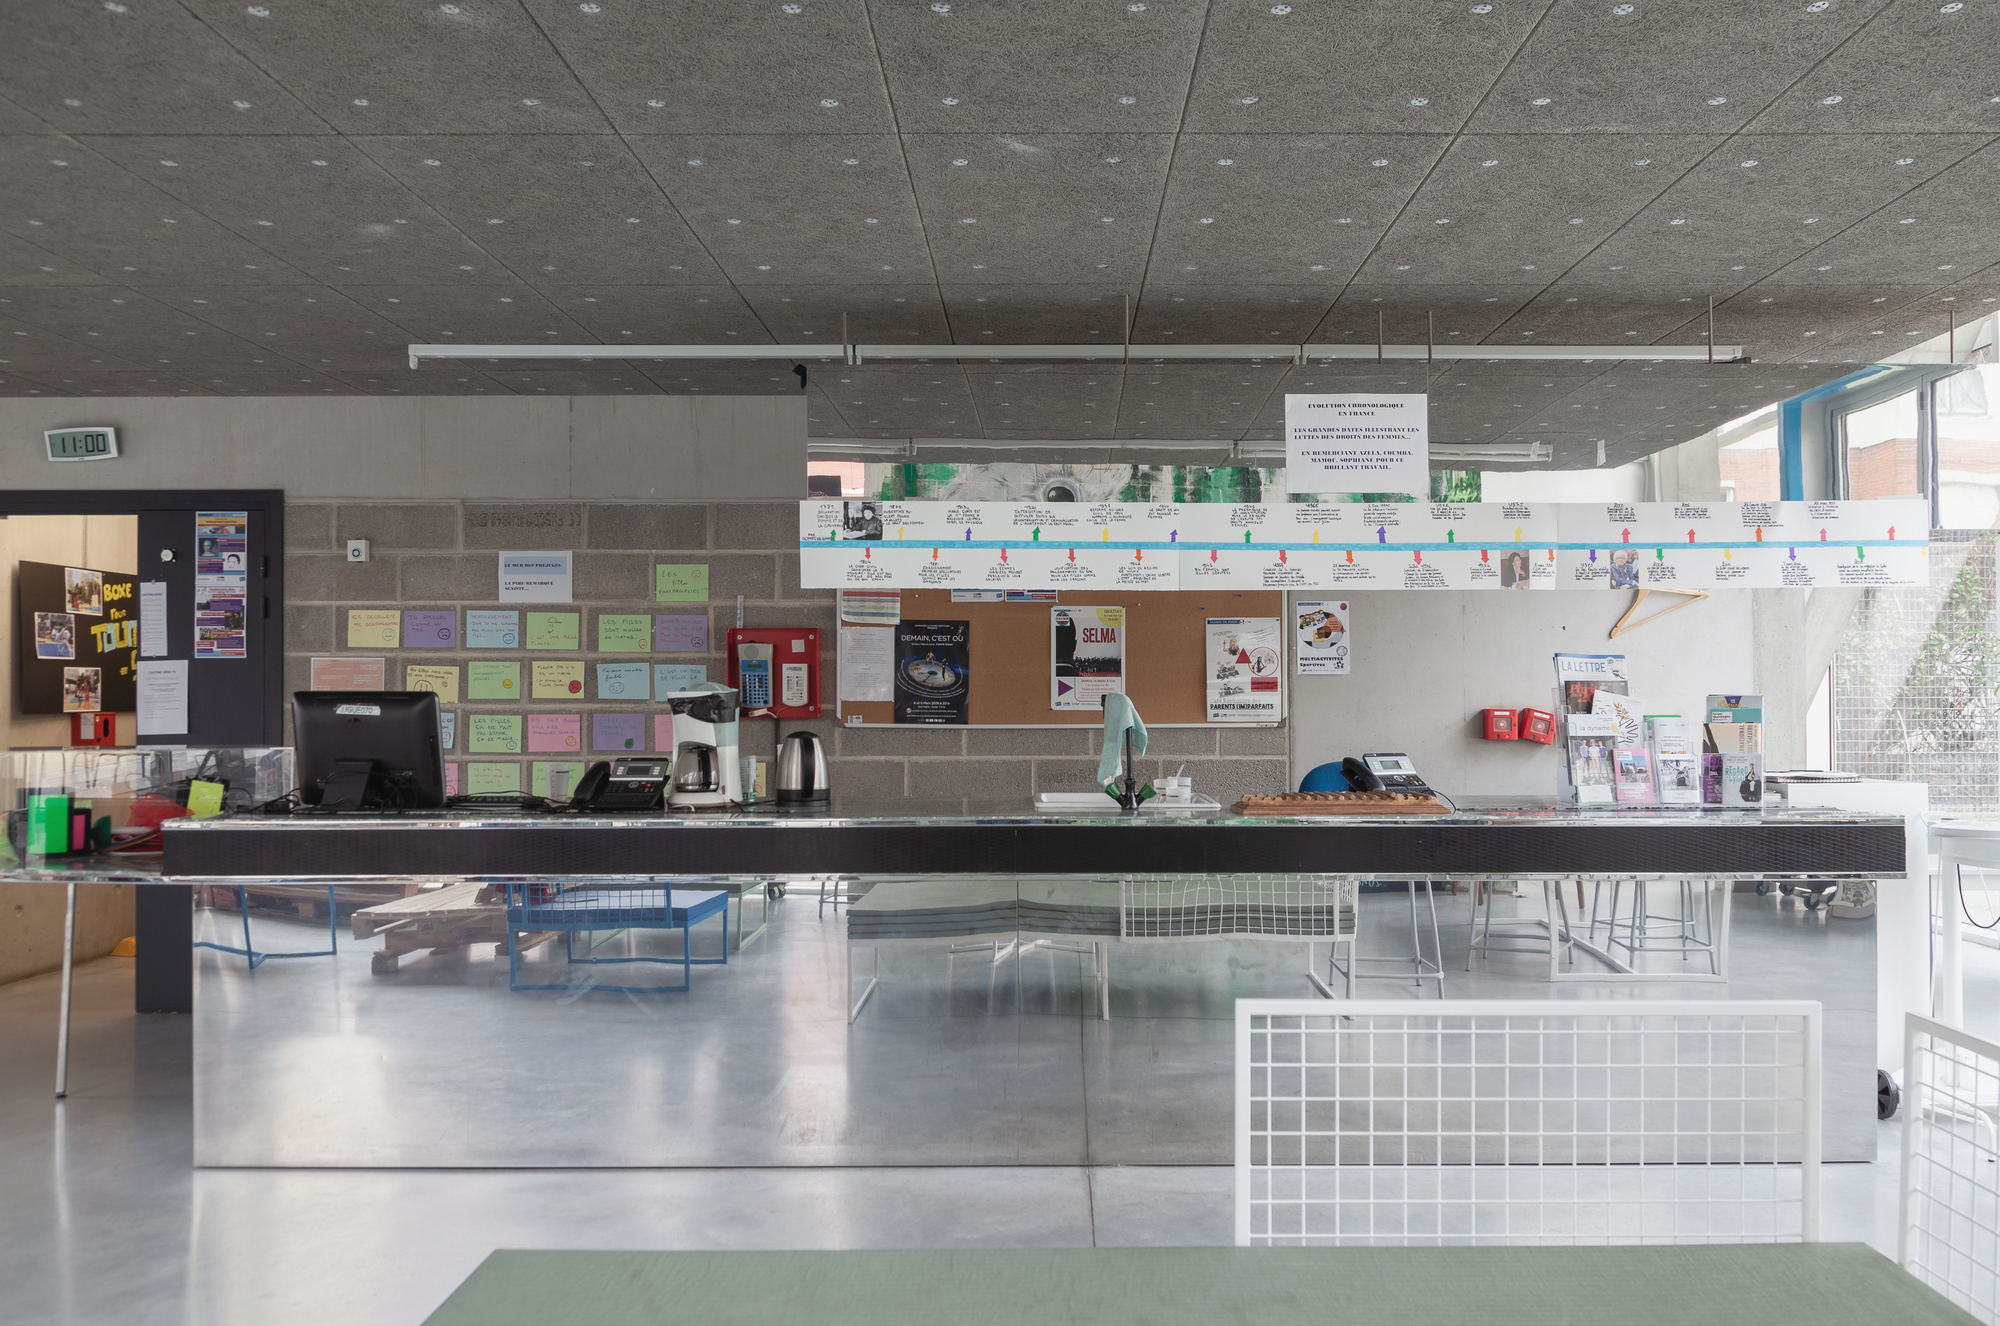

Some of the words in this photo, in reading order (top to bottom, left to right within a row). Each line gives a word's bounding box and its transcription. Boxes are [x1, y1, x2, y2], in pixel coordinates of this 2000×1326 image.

[62, 434, 106, 453] 11:00
[662, 570, 677, 578] LES
[103, 583, 132, 602] BOXE
[1082, 627, 1117, 644] SELMA
[1561, 660, 1573, 671] LA
[1573, 661, 1606, 673] LETTRE
